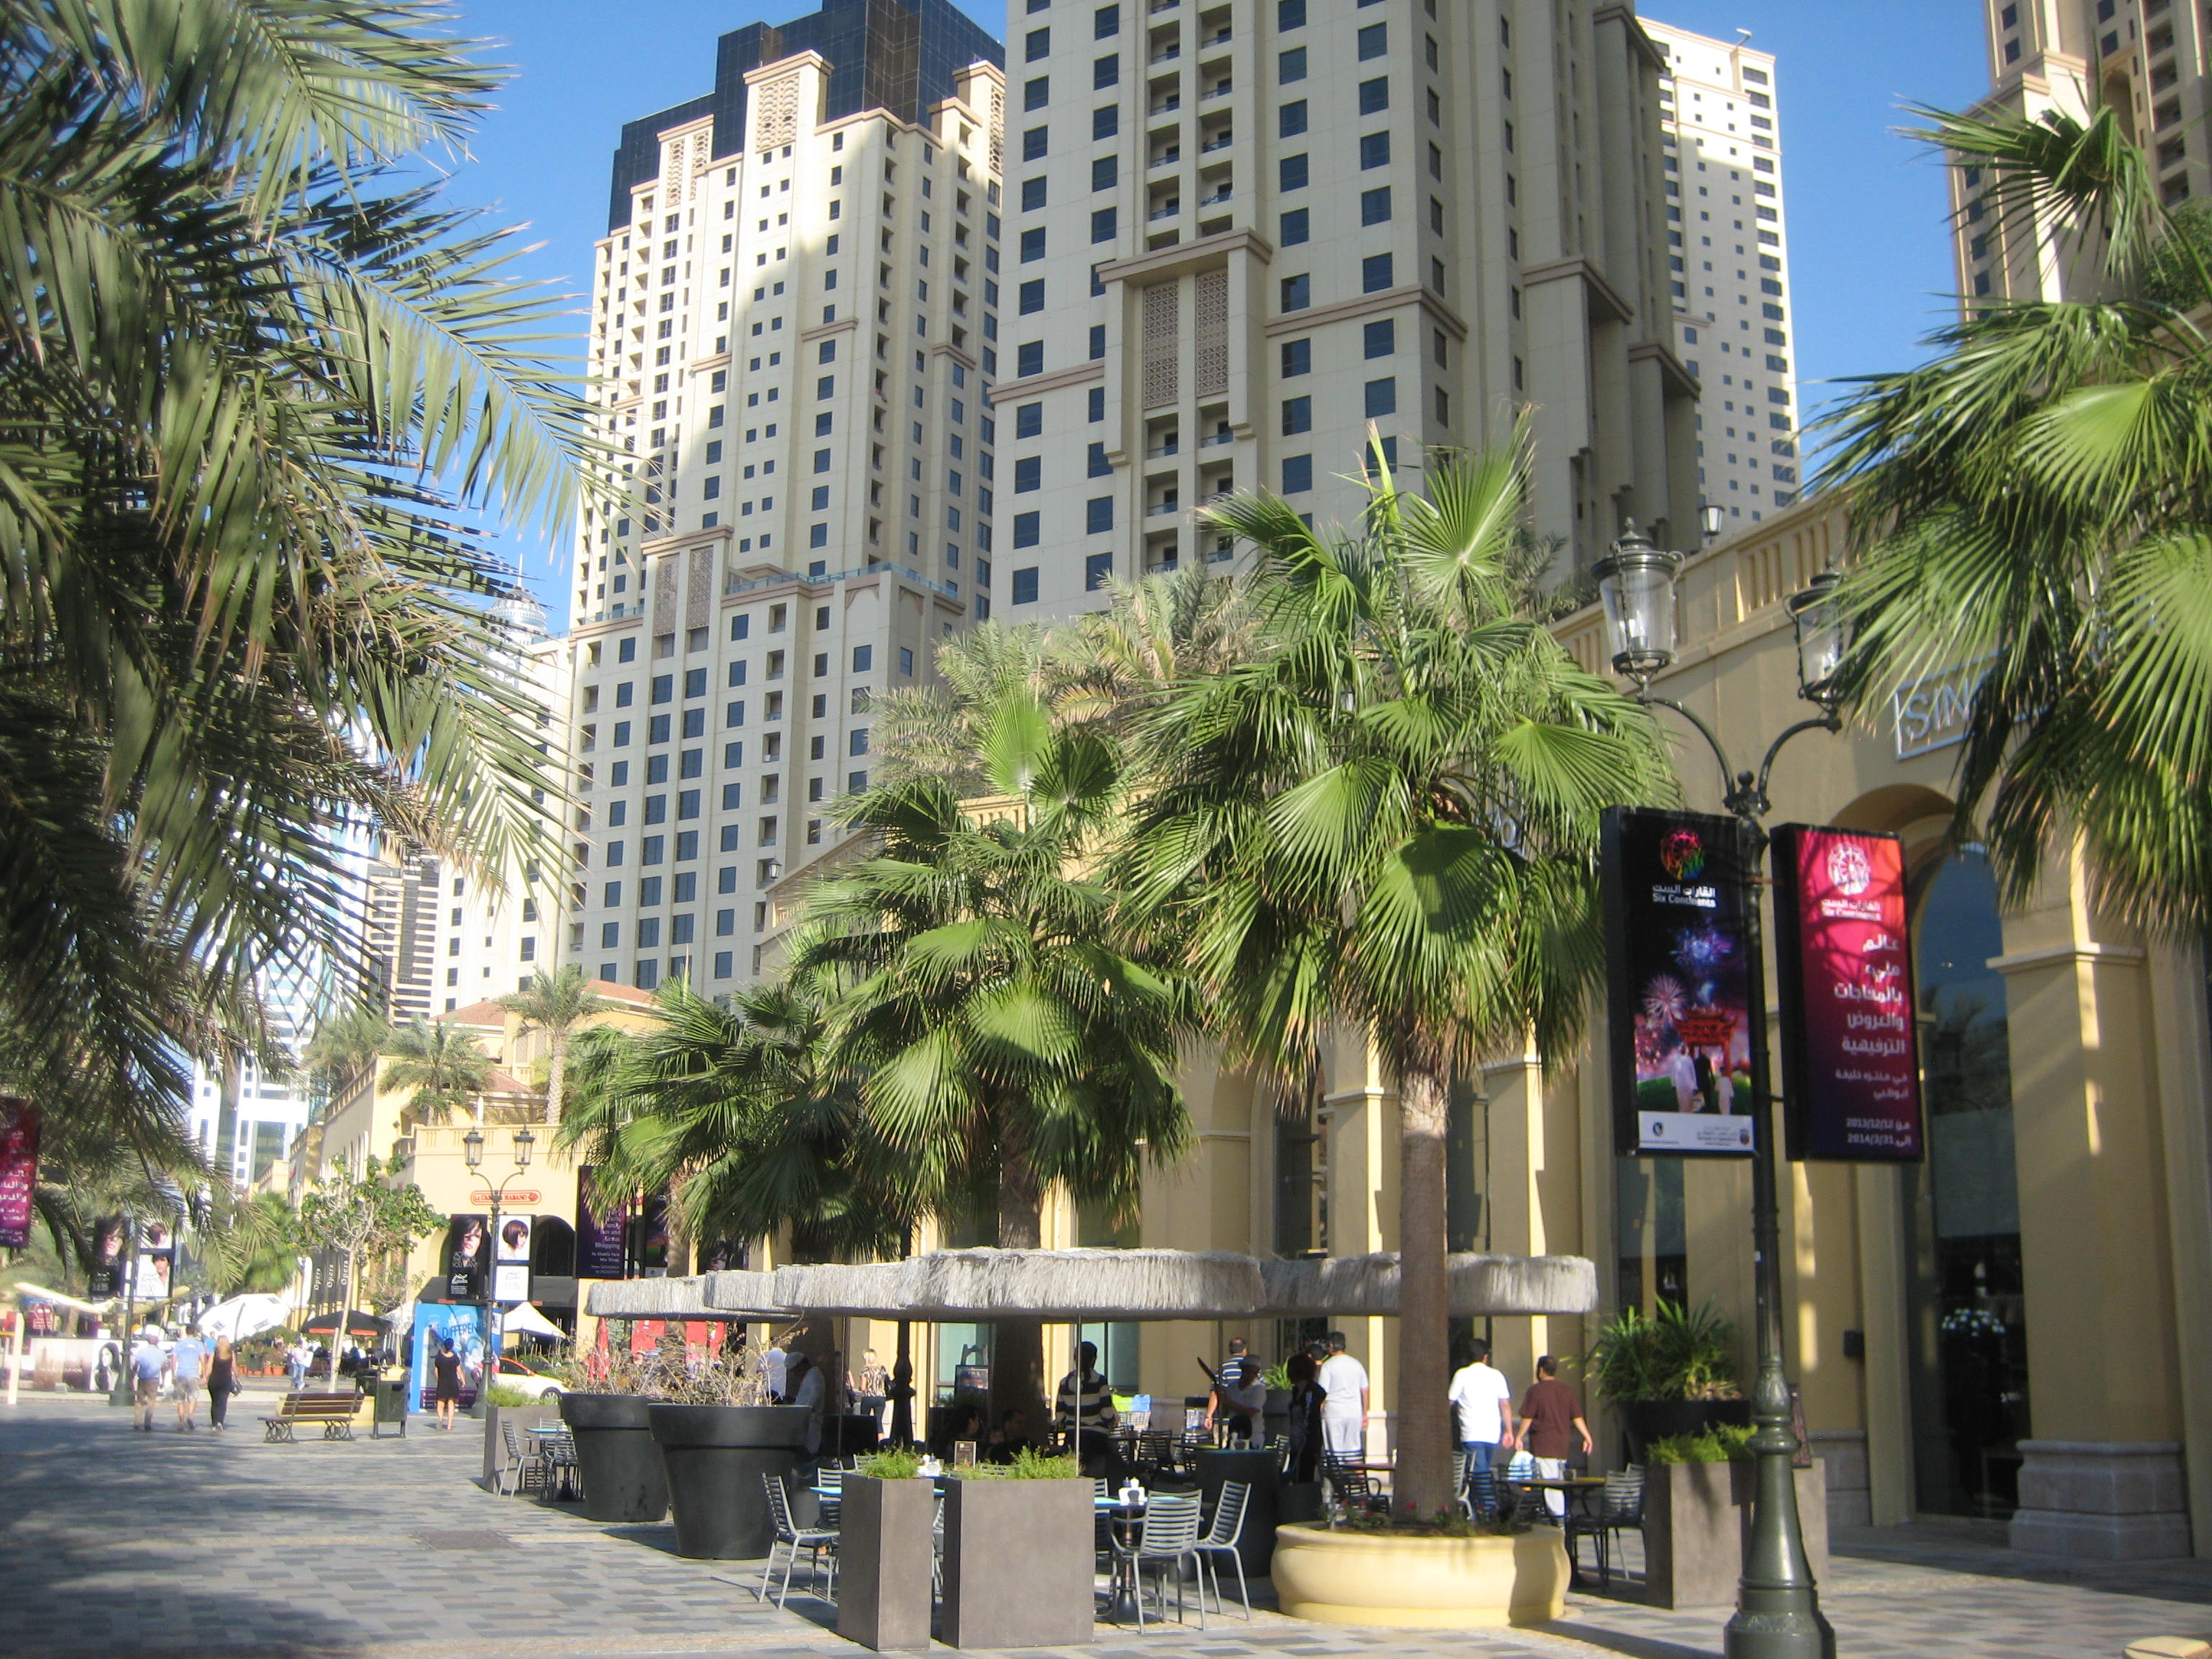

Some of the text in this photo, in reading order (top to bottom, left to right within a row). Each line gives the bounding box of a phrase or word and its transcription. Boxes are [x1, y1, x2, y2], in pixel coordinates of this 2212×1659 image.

[1653, 893, 1666, 902] Six
[1863, 933, 1899, 952] عالم
[1847, 1010, 1904, 1031] والعروض
[1842, 1035, 1906, 1056] الترفيهية
